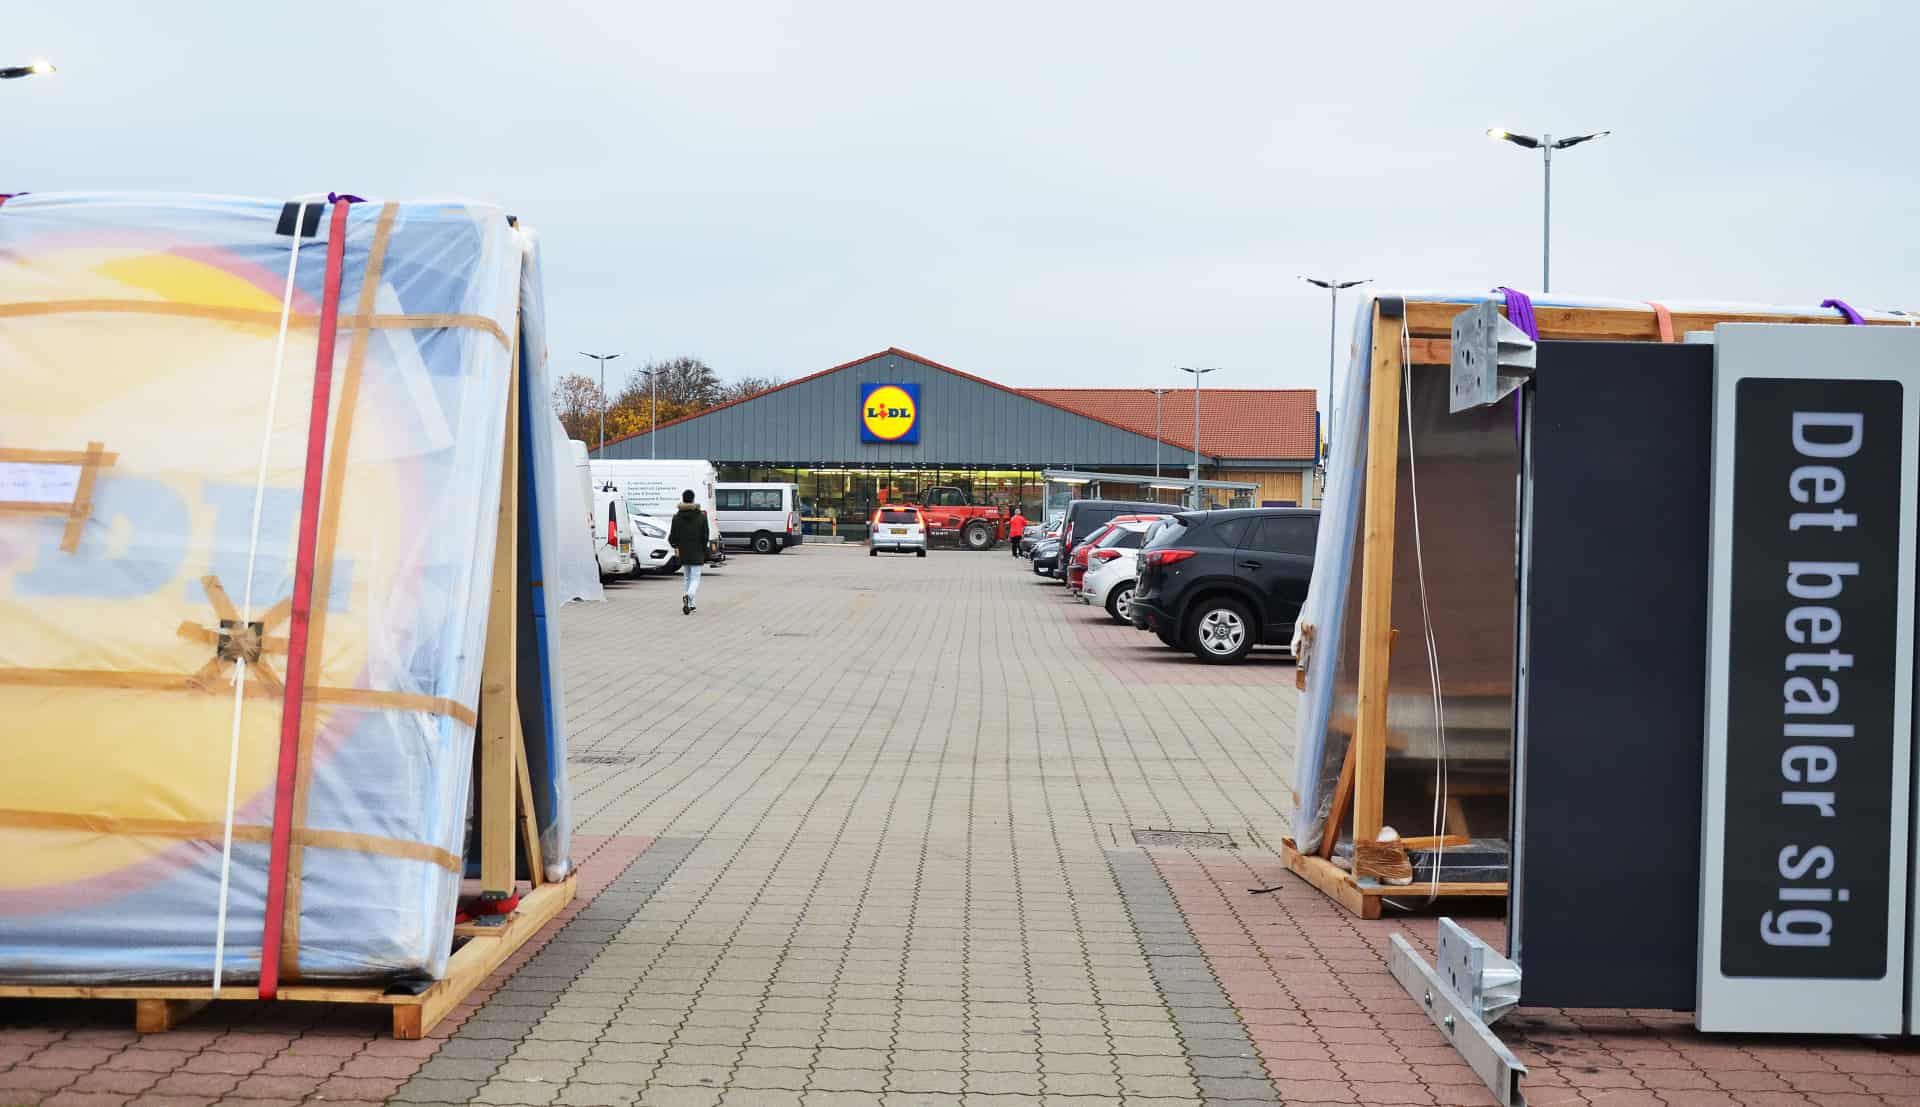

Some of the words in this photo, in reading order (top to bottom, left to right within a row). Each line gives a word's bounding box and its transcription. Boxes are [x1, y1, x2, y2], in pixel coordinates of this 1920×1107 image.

[1790, 412, 1862, 530] Det
[1782, 561, 1858, 818] betaler
[1760, 845, 1848, 945] sig
